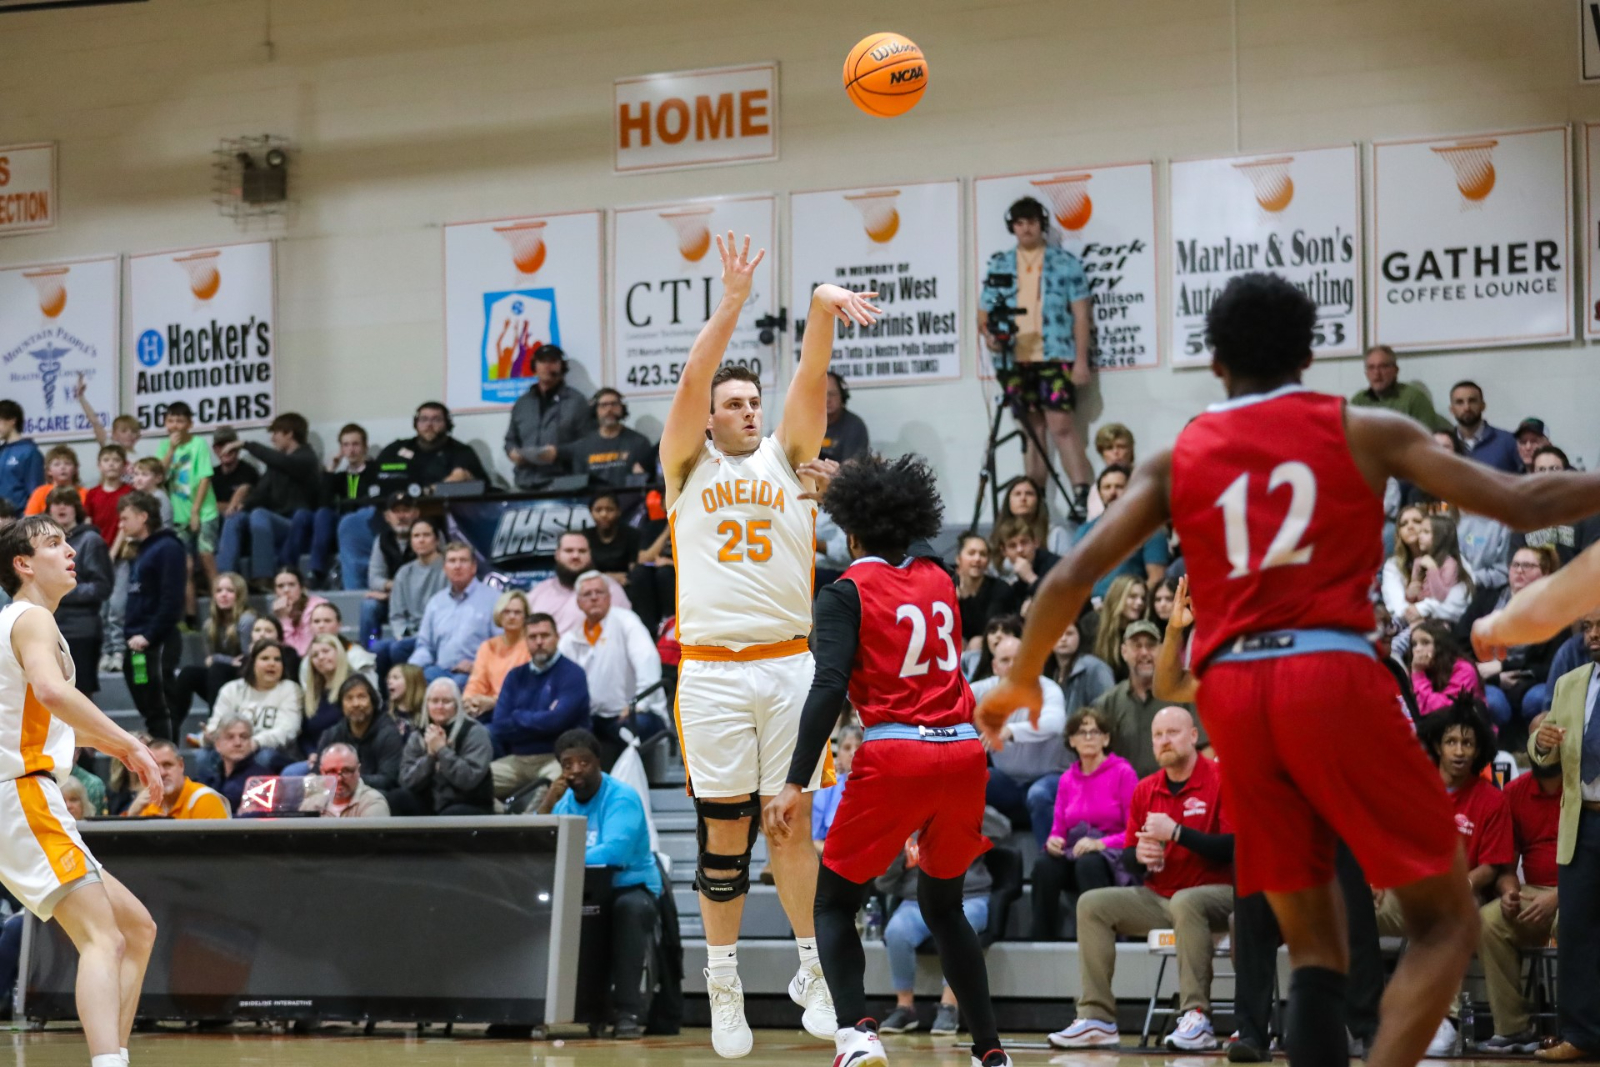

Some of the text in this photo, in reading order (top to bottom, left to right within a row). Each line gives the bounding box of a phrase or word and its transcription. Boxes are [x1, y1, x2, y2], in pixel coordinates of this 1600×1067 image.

[870, 43, 917, 61] Wilson
[890, 65, 924, 85] NCAA
[619, 89, 770, 149] HOME
[1082, 239, 1146, 258] Fork
[1176, 225, 1354, 275] Marlar & Son's
[1382, 240, 1561, 283] GATHER
[836, 262, 910, 277] IN MEMORY OF
[626, 277, 716, 328] CTI
[869, 279, 896, 304] Roy
[899, 276, 938, 300] West
[1093, 292, 1145, 305] Allison
[1387, 277, 1557, 304] COFFEE LOUNGE
[837, 315, 855, 340] De
[917, 310, 956, 335] West
[1097, 306, 1128, 321] DPT
[168, 315, 270, 366] Hacker's
[136, 362, 271, 395] Automotive
[137, 393, 271, 430] 56-CARS
[701, 479, 785, 514] ONEIDA
[1214, 460, 1318, 580] 12
[717, 519, 773, 563] 25
[896, 601, 958, 679] 23
